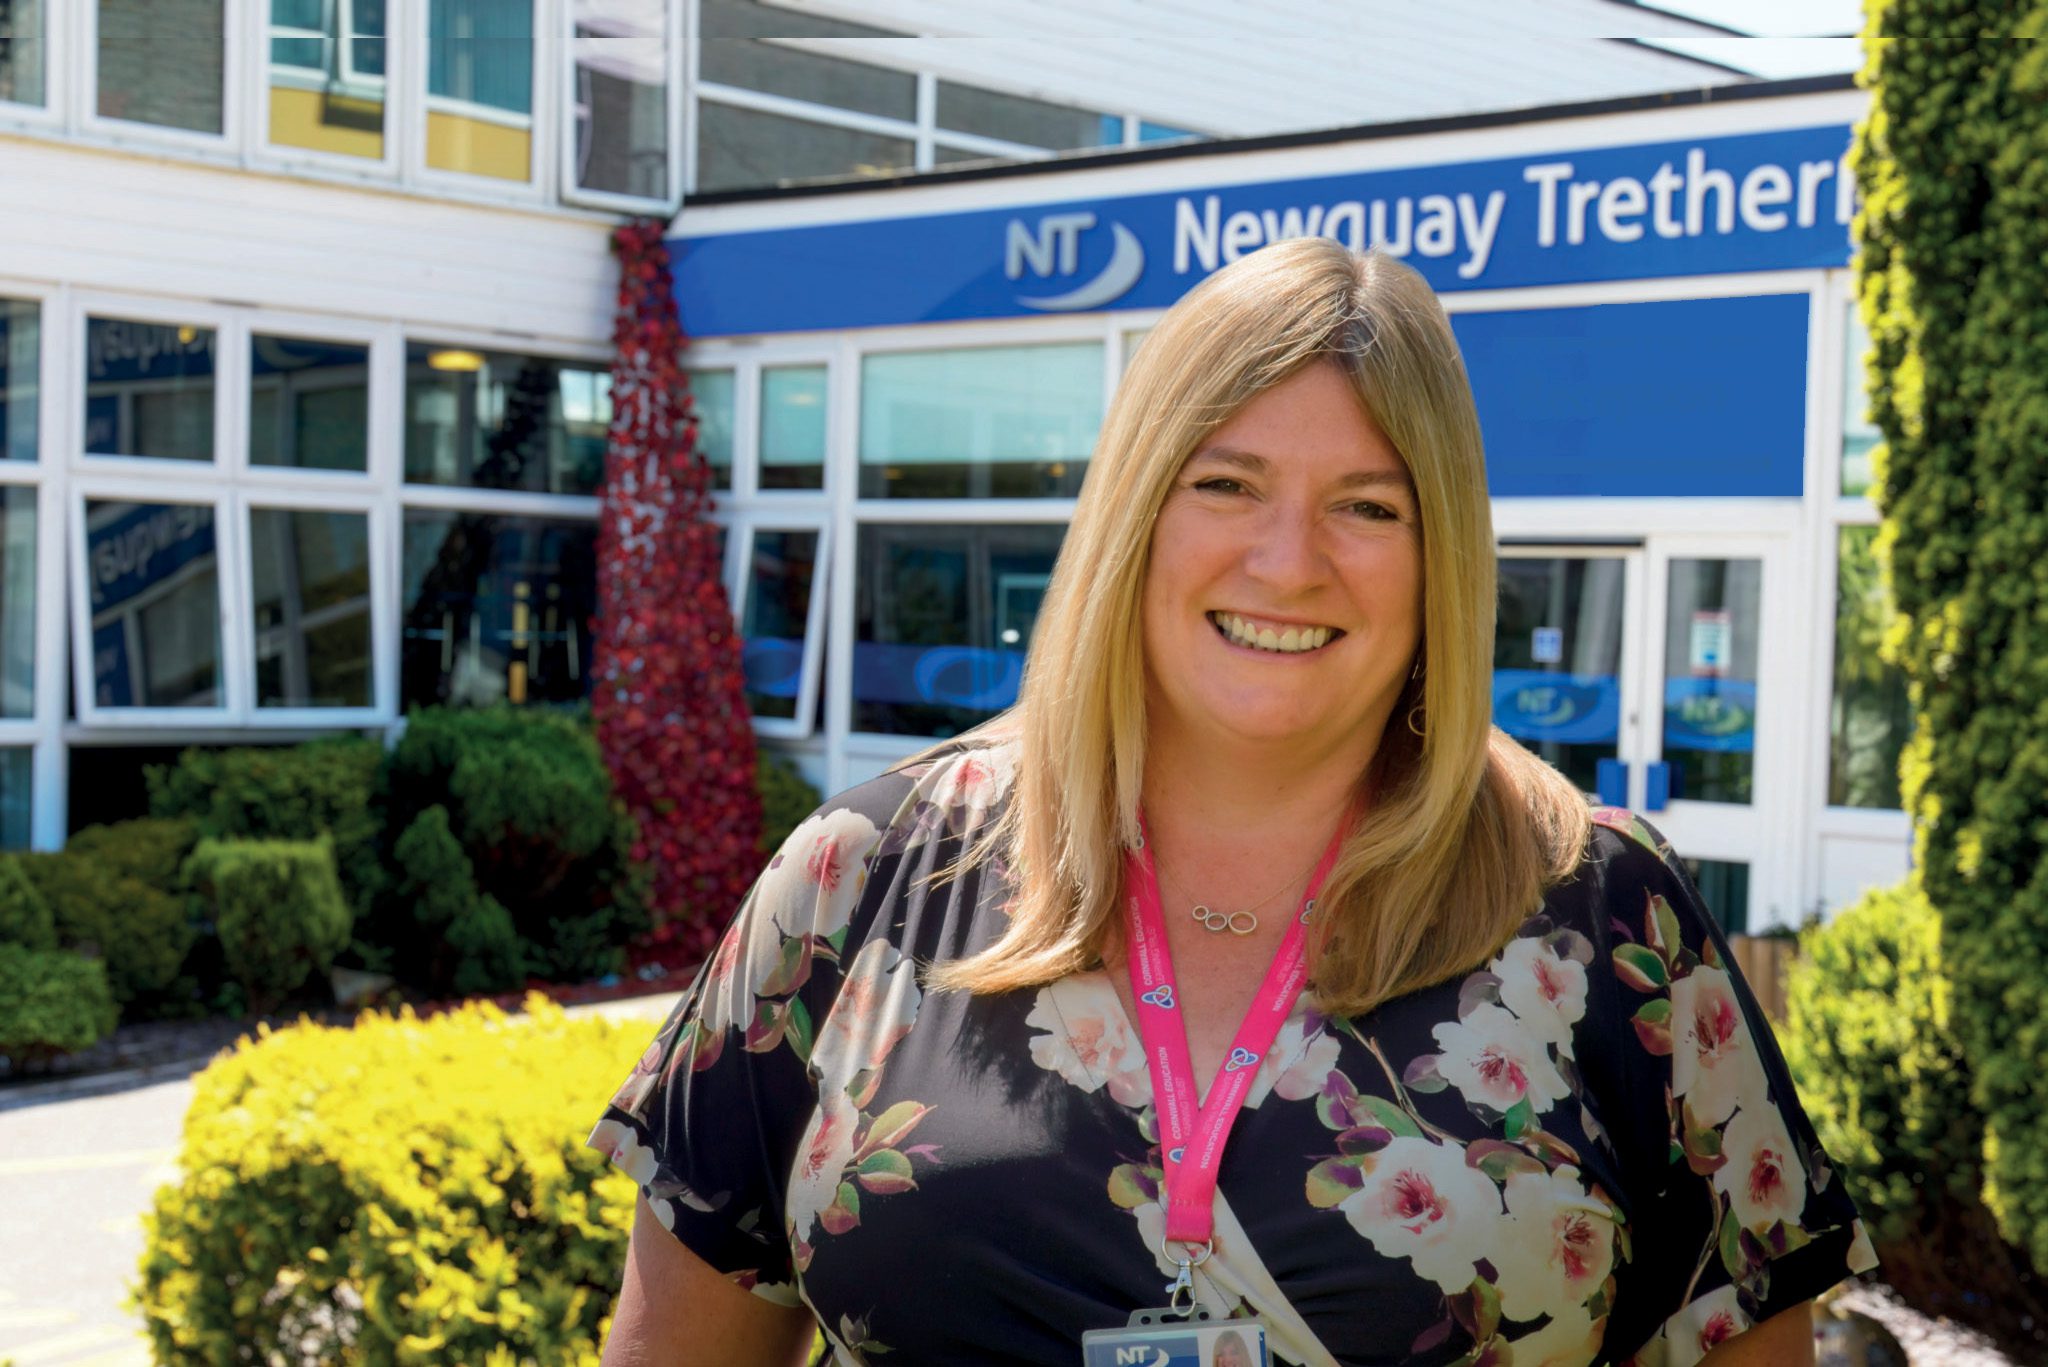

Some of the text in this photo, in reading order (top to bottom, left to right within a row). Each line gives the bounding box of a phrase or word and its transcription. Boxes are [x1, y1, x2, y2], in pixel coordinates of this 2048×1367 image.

[1005, 211, 1096, 280] NT
[1174, 188, 1505, 279] Newquay
[1129, 896, 1153, 986] CORNWALL EDUCATION
[1158, 1046, 1182, 1140] CORNWALL EDUCATION
[1220, 1072, 1246, 1117] CORNWALL
[1200, 1117, 1224, 1169] EDUCATION
[1116, 1345, 1151, 1365] NT
